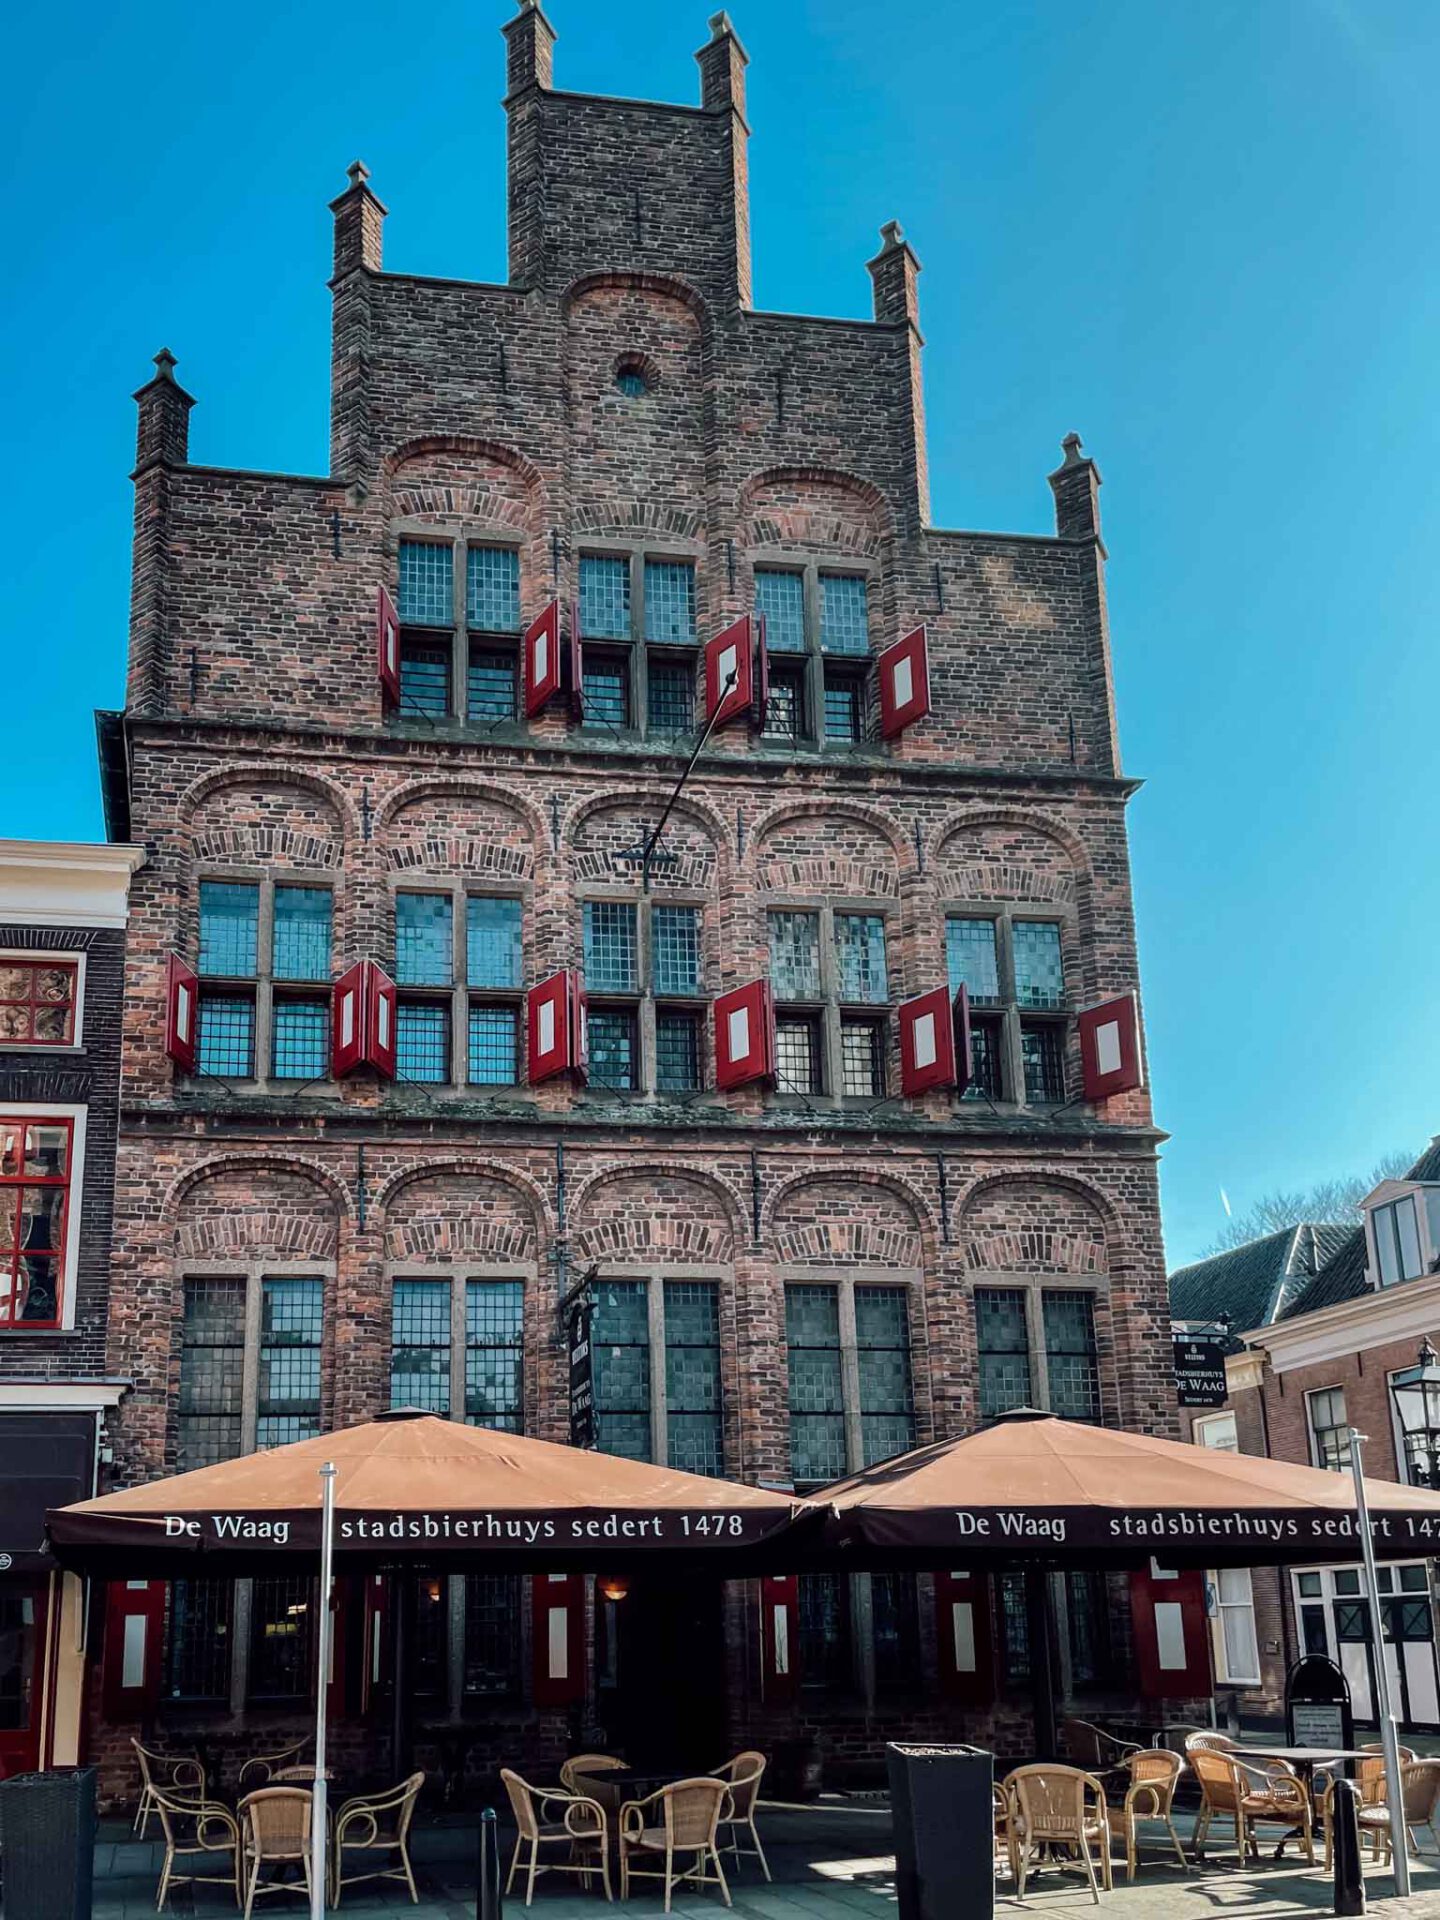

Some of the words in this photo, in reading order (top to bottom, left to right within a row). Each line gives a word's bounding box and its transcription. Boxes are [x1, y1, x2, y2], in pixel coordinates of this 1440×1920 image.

[1174, 1370, 1224, 1378] TADSBIERHUYS
[1188, 1379, 1225, 1392] WAAG
[163, 1516, 202, 1537] De
[211, 1516, 290, 1544] Waag
[341, 1514, 555, 1543] stadsbierhuys
[571, 1514, 664, 1537] sedert
[680, 1515, 743, 1536] 1478
[955, 1512, 990, 1535] De
[996, 1513, 1066, 1541] Waag
[1109, 1513, 1298, 1540] stadsbierhuys
